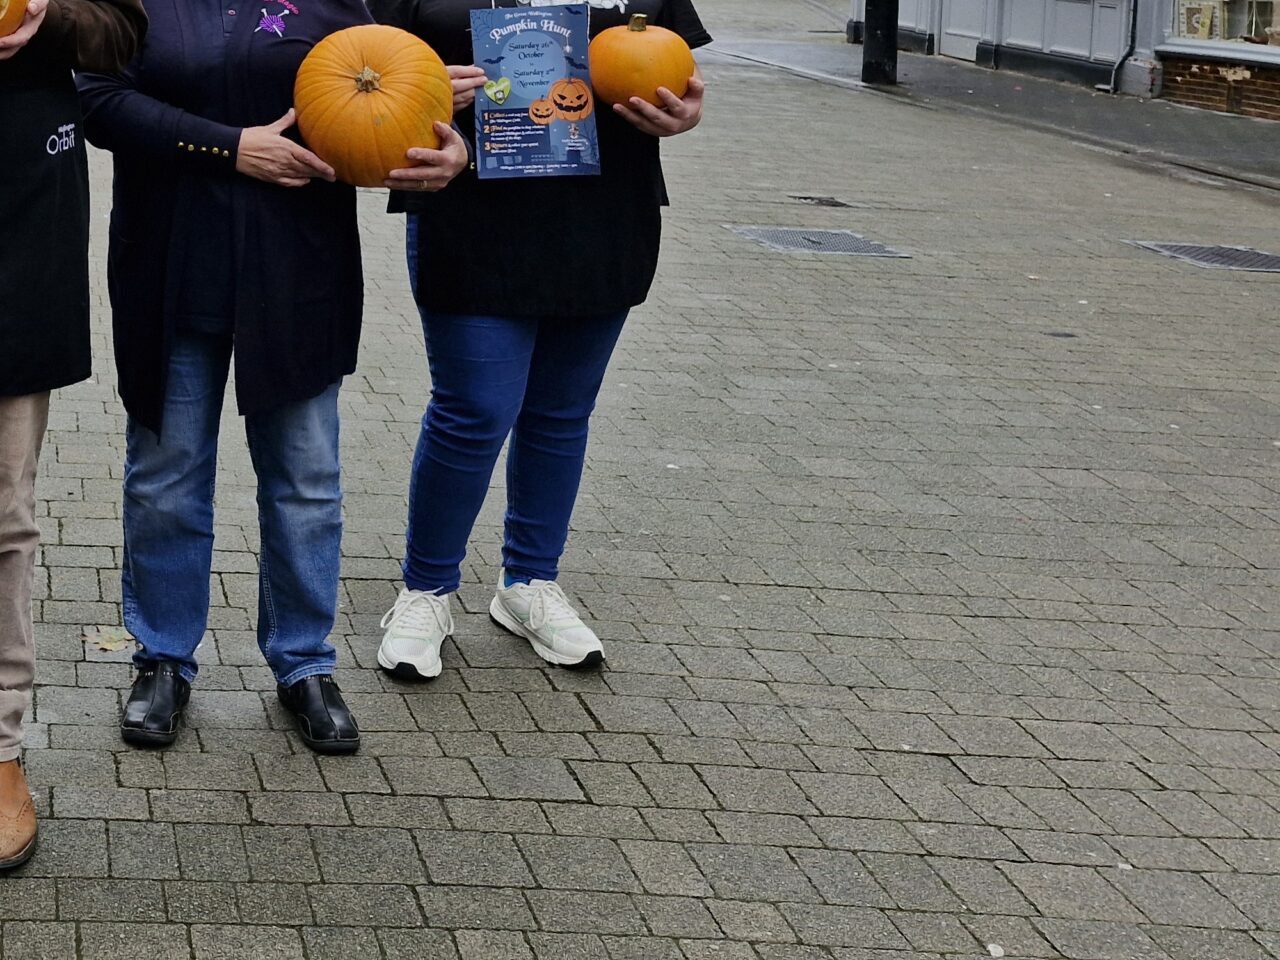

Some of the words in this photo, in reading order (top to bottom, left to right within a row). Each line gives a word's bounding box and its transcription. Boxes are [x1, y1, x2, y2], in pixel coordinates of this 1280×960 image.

[489, 19, 537, 44] Pumpkin
[540, 19, 572, 38] Hunt
[508, 41, 540, 52] Saturday
[518, 52, 545, 61] October
[513, 69, 544, 79] Saturday
[517, 79, 550, 88] November
[483, 112, 488, 120] 1
[483, 125, 490, 133] 2
[46, 129, 75, 155] Orbit
[484, 142, 491, 150] 3
